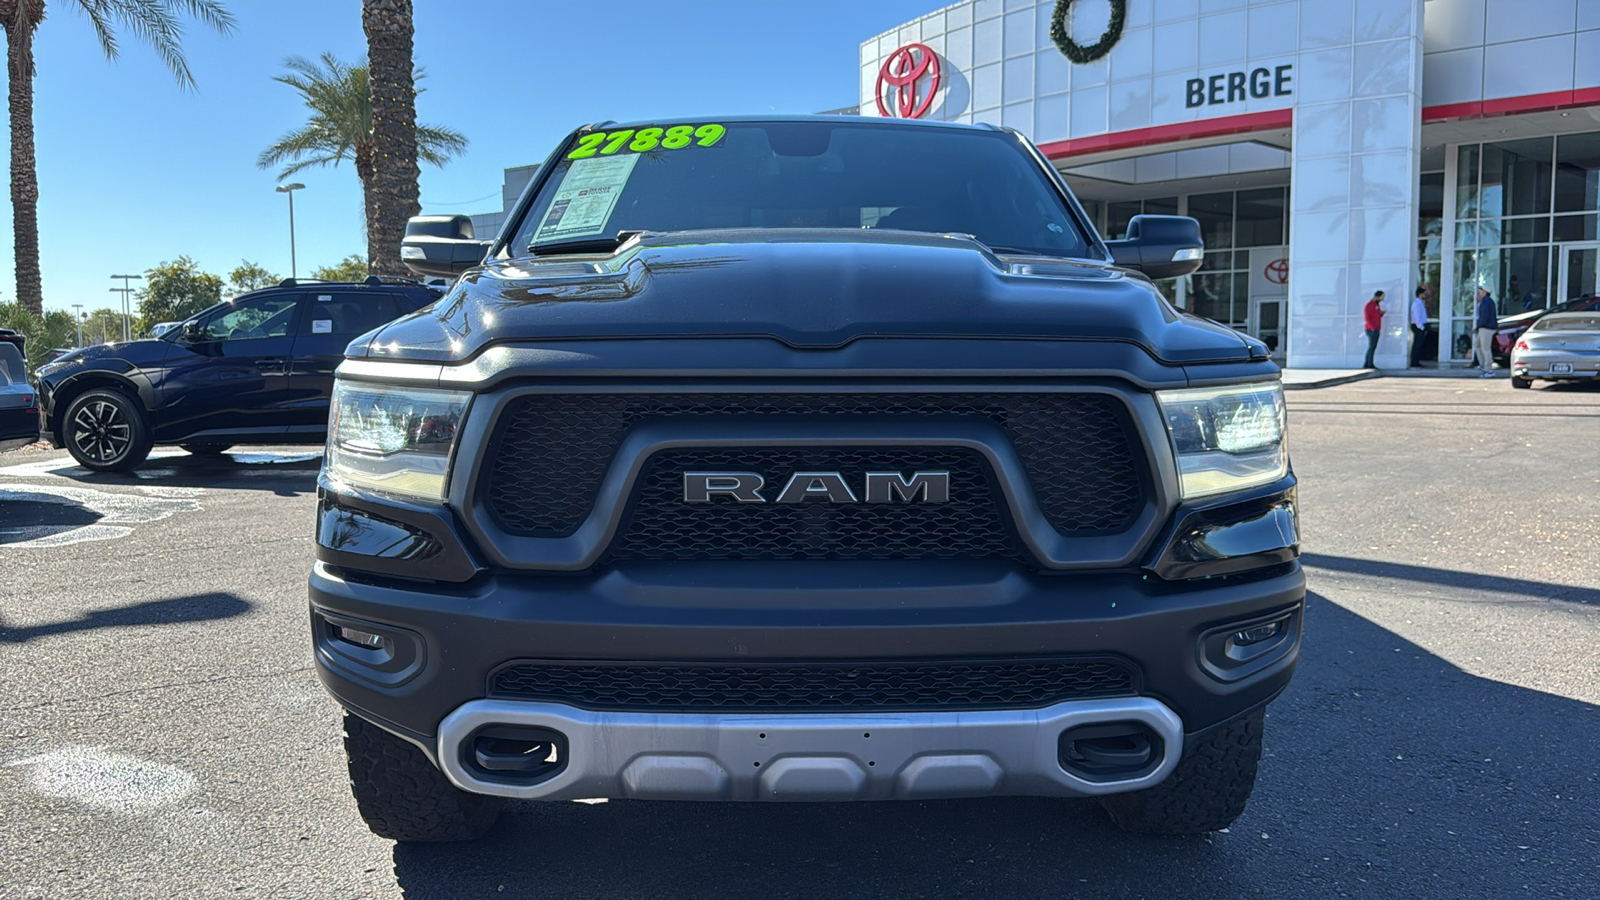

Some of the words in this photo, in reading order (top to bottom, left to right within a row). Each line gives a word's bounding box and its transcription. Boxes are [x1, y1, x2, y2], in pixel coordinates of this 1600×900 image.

[1185, 64, 1293, 109] BERGE
[567, 124, 726, 159] 27889
[683, 471, 950, 502] RAM
